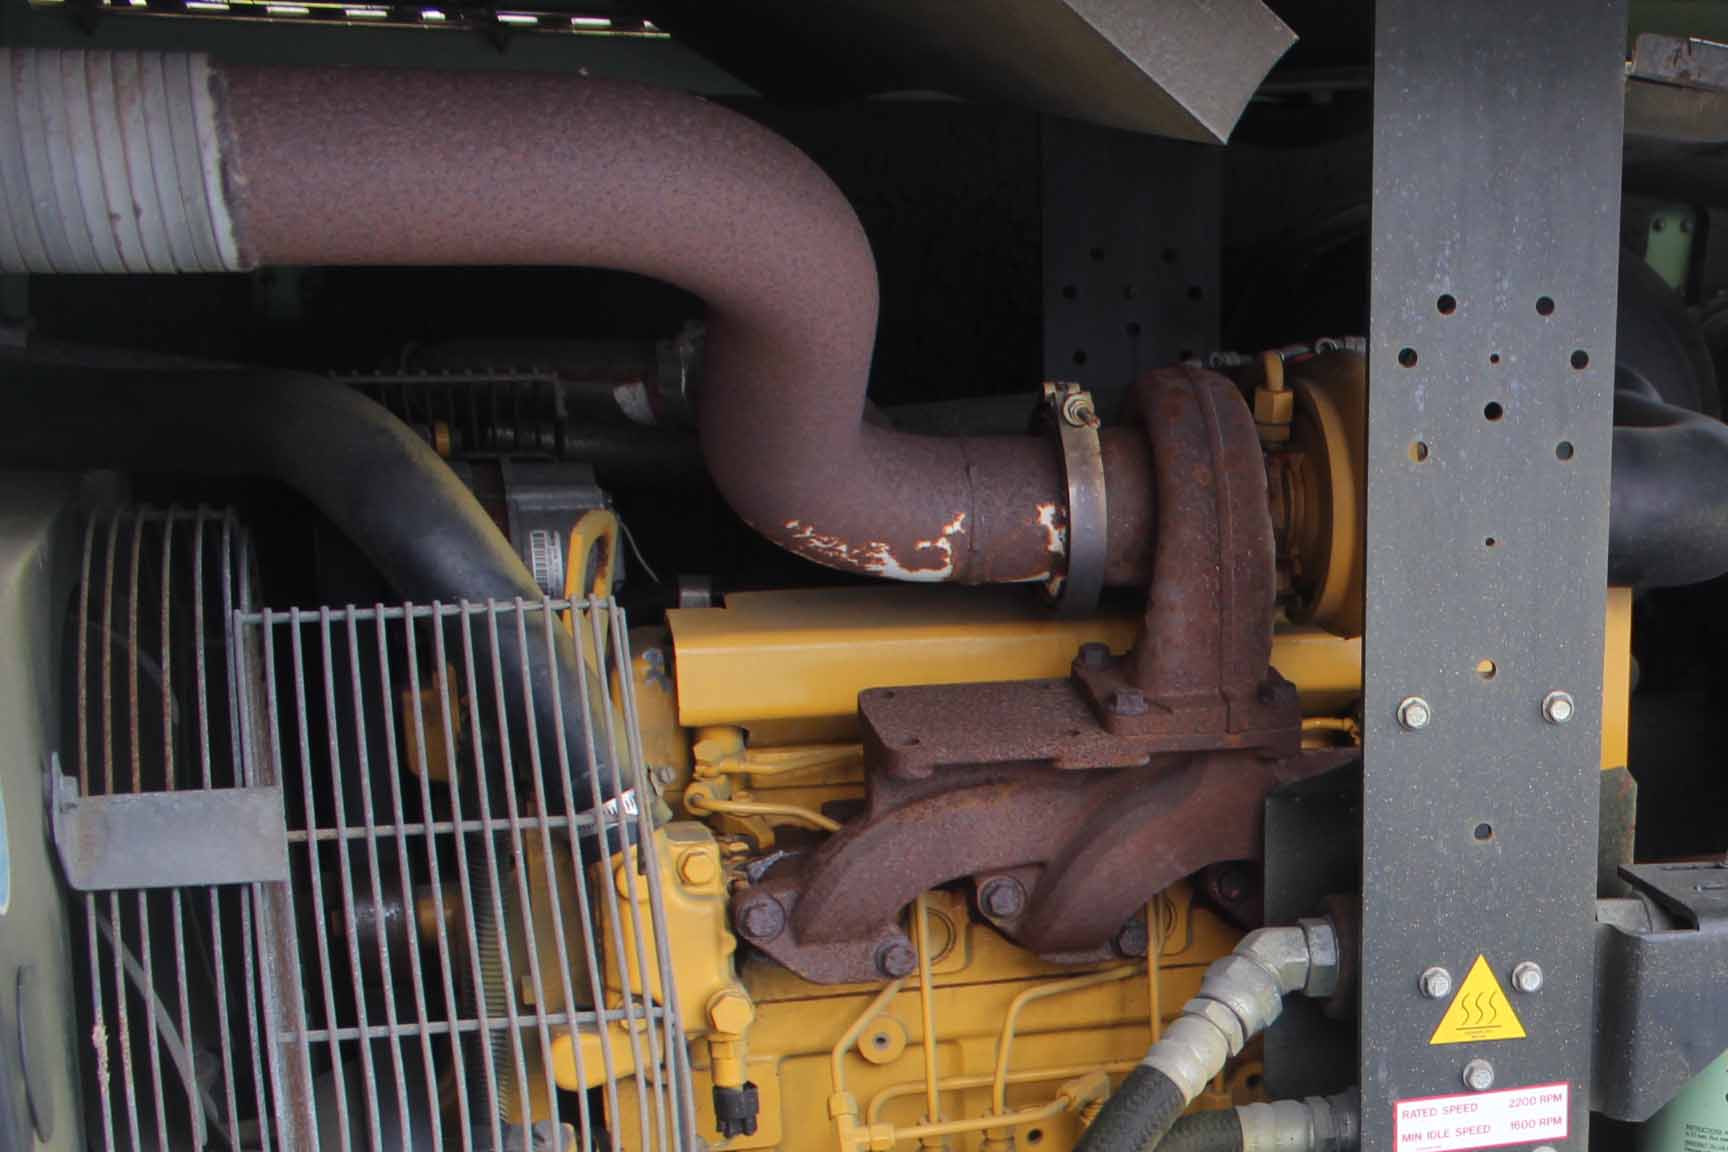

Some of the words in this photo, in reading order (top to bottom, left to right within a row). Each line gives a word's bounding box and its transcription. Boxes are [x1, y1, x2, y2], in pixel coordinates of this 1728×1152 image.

[1402, 1107, 1438, 1120] RATED
[1442, 1103, 1479, 1116] SPEED
[1509, 1096, 1537, 1109] 2200
[1540, 1093, 1563, 1105] RPM
[1401, 1130, 1423, 1144] MIN
[1427, 1128, 1450, 1141] IDLE
[1455, 1124, 1491, 1137] SPEED
[1510, 1119, 1536, 1131] 1600
[1539, 1116, 1563, 1128] RPM
